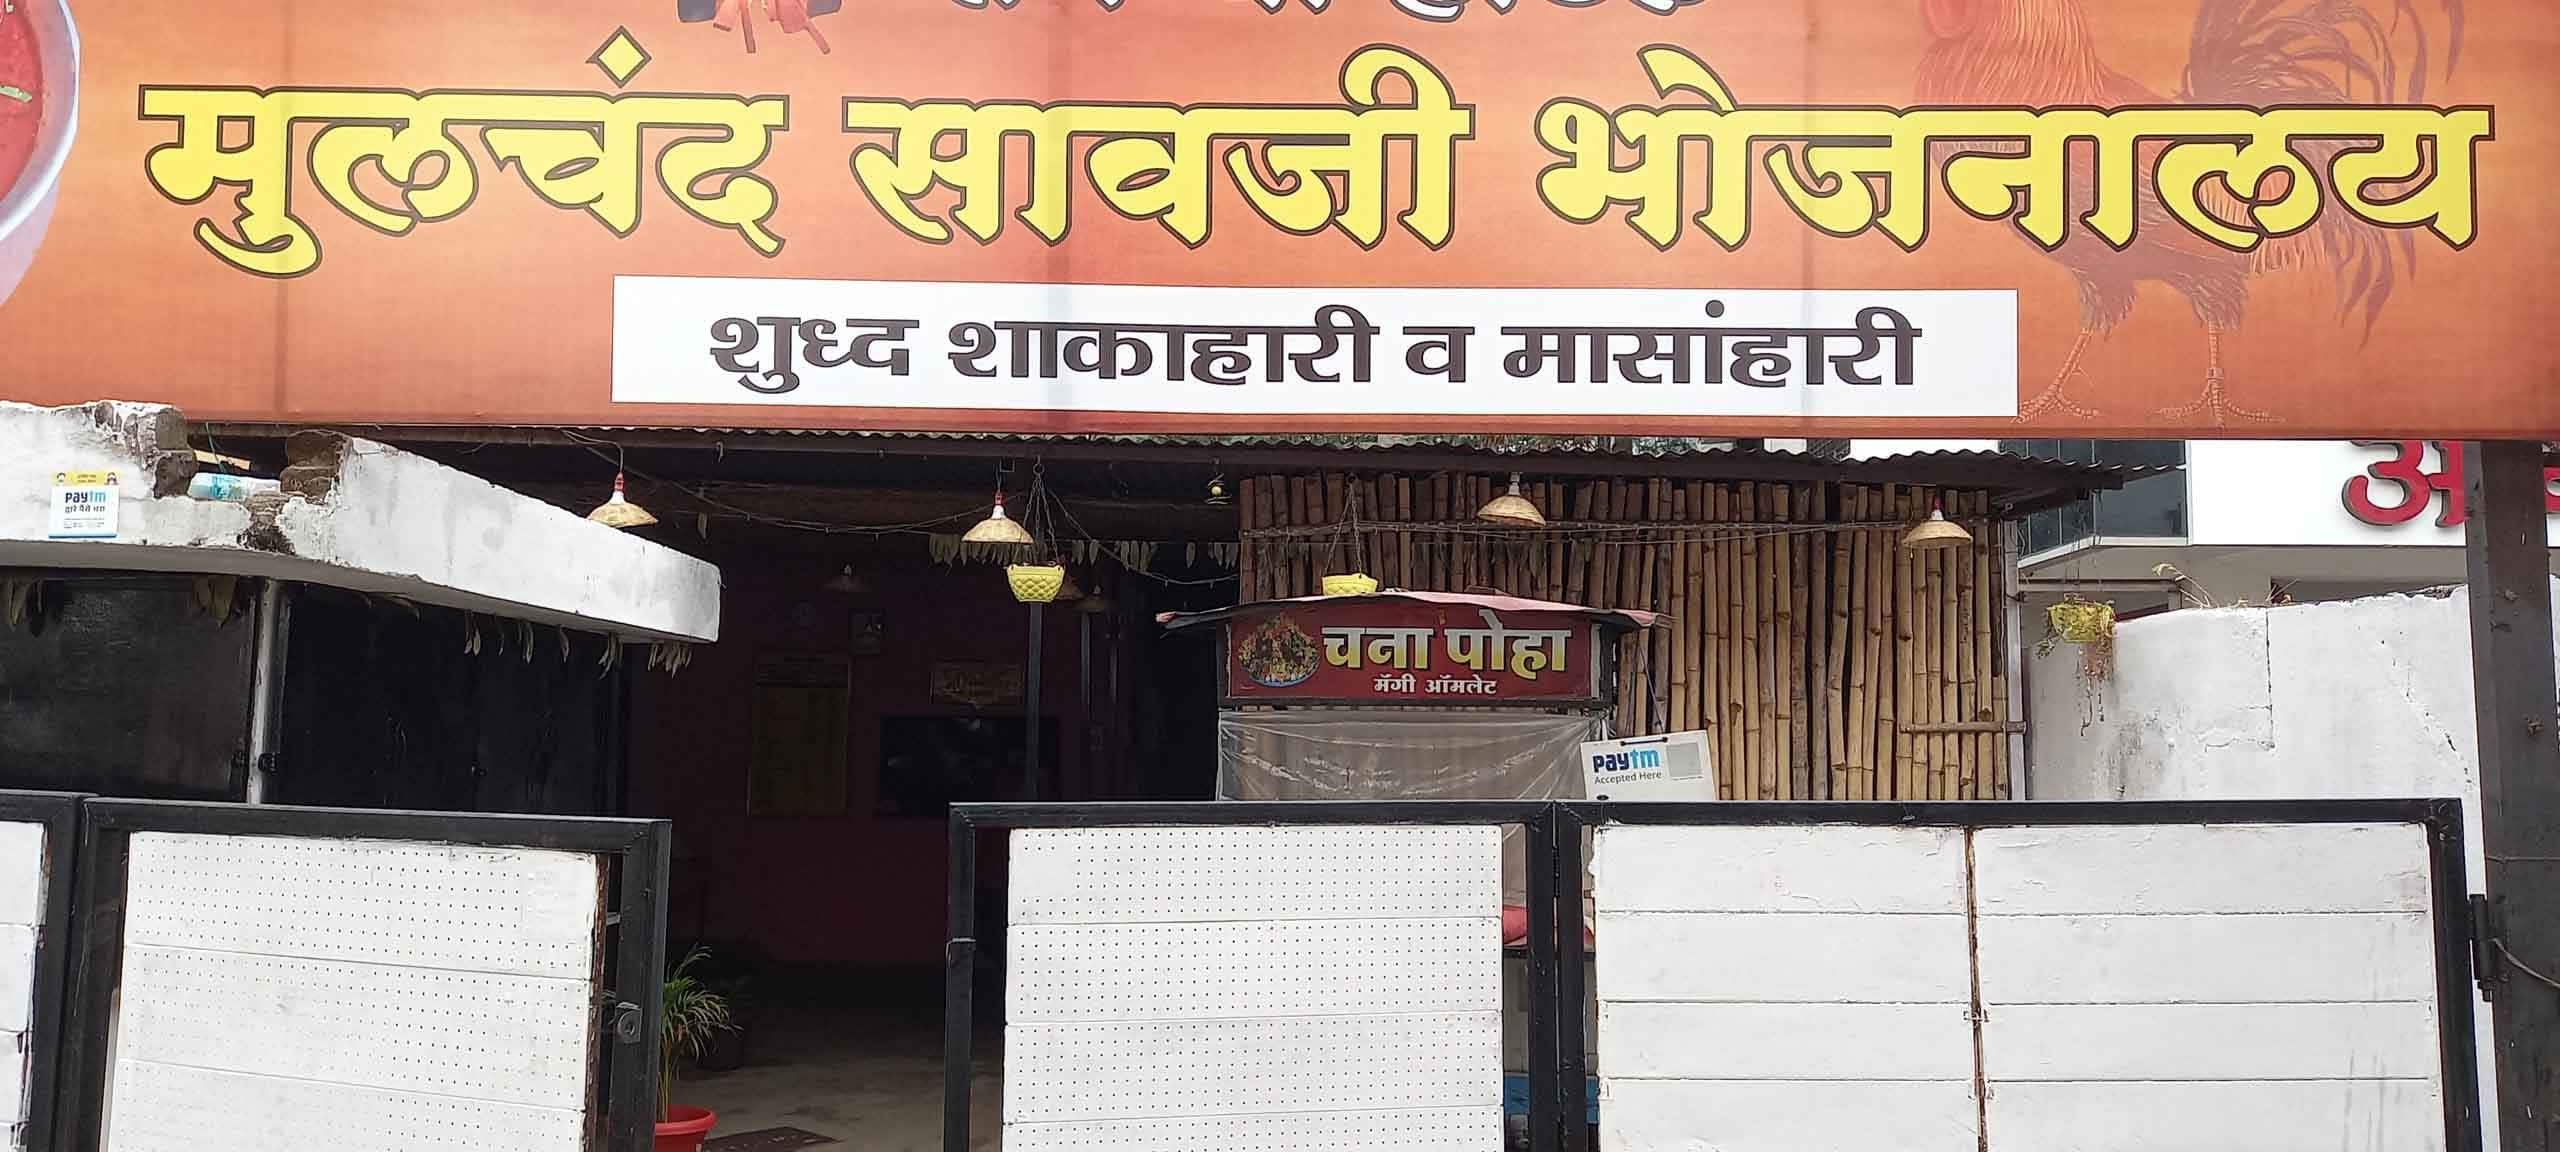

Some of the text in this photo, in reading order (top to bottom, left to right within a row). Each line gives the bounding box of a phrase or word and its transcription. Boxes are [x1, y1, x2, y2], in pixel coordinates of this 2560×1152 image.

[138, 25, 2495, 279] मुलचंद सावजी भोजनालय
[948, 304, 1380, 386] शाकाहारी
[1403, 326, 1475, 382] व
[1501, 299, 1922, 388] मासांहारी
[1321, 608, 1572, 680] चना पोहा
[1424, 674, 1497, 694] ऑमलेट
[1592, 748, 1661, 773] paytm
[1594, 771, 1662, 785] Accepted Here
